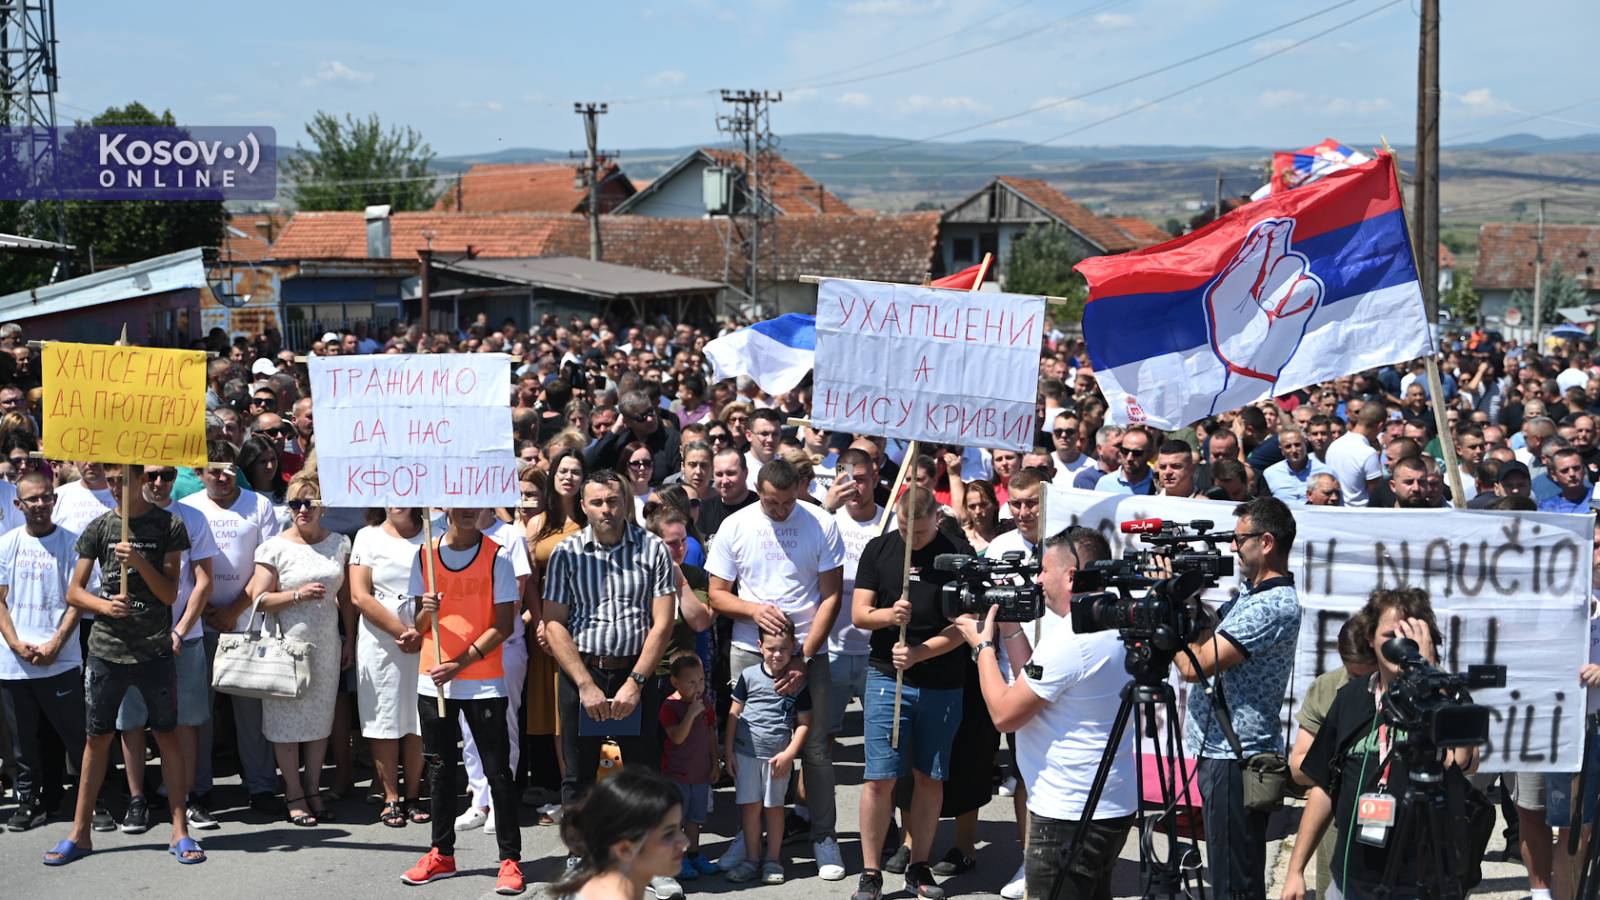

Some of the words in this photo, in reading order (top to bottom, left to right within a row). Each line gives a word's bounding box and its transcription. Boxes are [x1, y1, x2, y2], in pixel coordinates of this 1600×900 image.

[839, 296, 1036, 346] УХАПШЕНИ
[56, 349, 140, 384] ХАПСЕ
[145, 353, 194, 391] НАС
[326, 367, 477, 397] ТРАЖИМО
[914, 355, 935, 383] А
[49, 388, 84, 419] ДА
[93, 390, 200, 427] ПРОТЕРАЈУ
[824, 388, 913, 428] НИСУ
[925, 402, 1033, 450] КРИВИ!
[60, 427, 103, 456] СВЕ
[350, 418, 387, 445] ДА
[408, 419, 452, 445] НАС
[347, 462, 428, 497] КФОР
[444, 464, 517, 497] ШТИТИ
